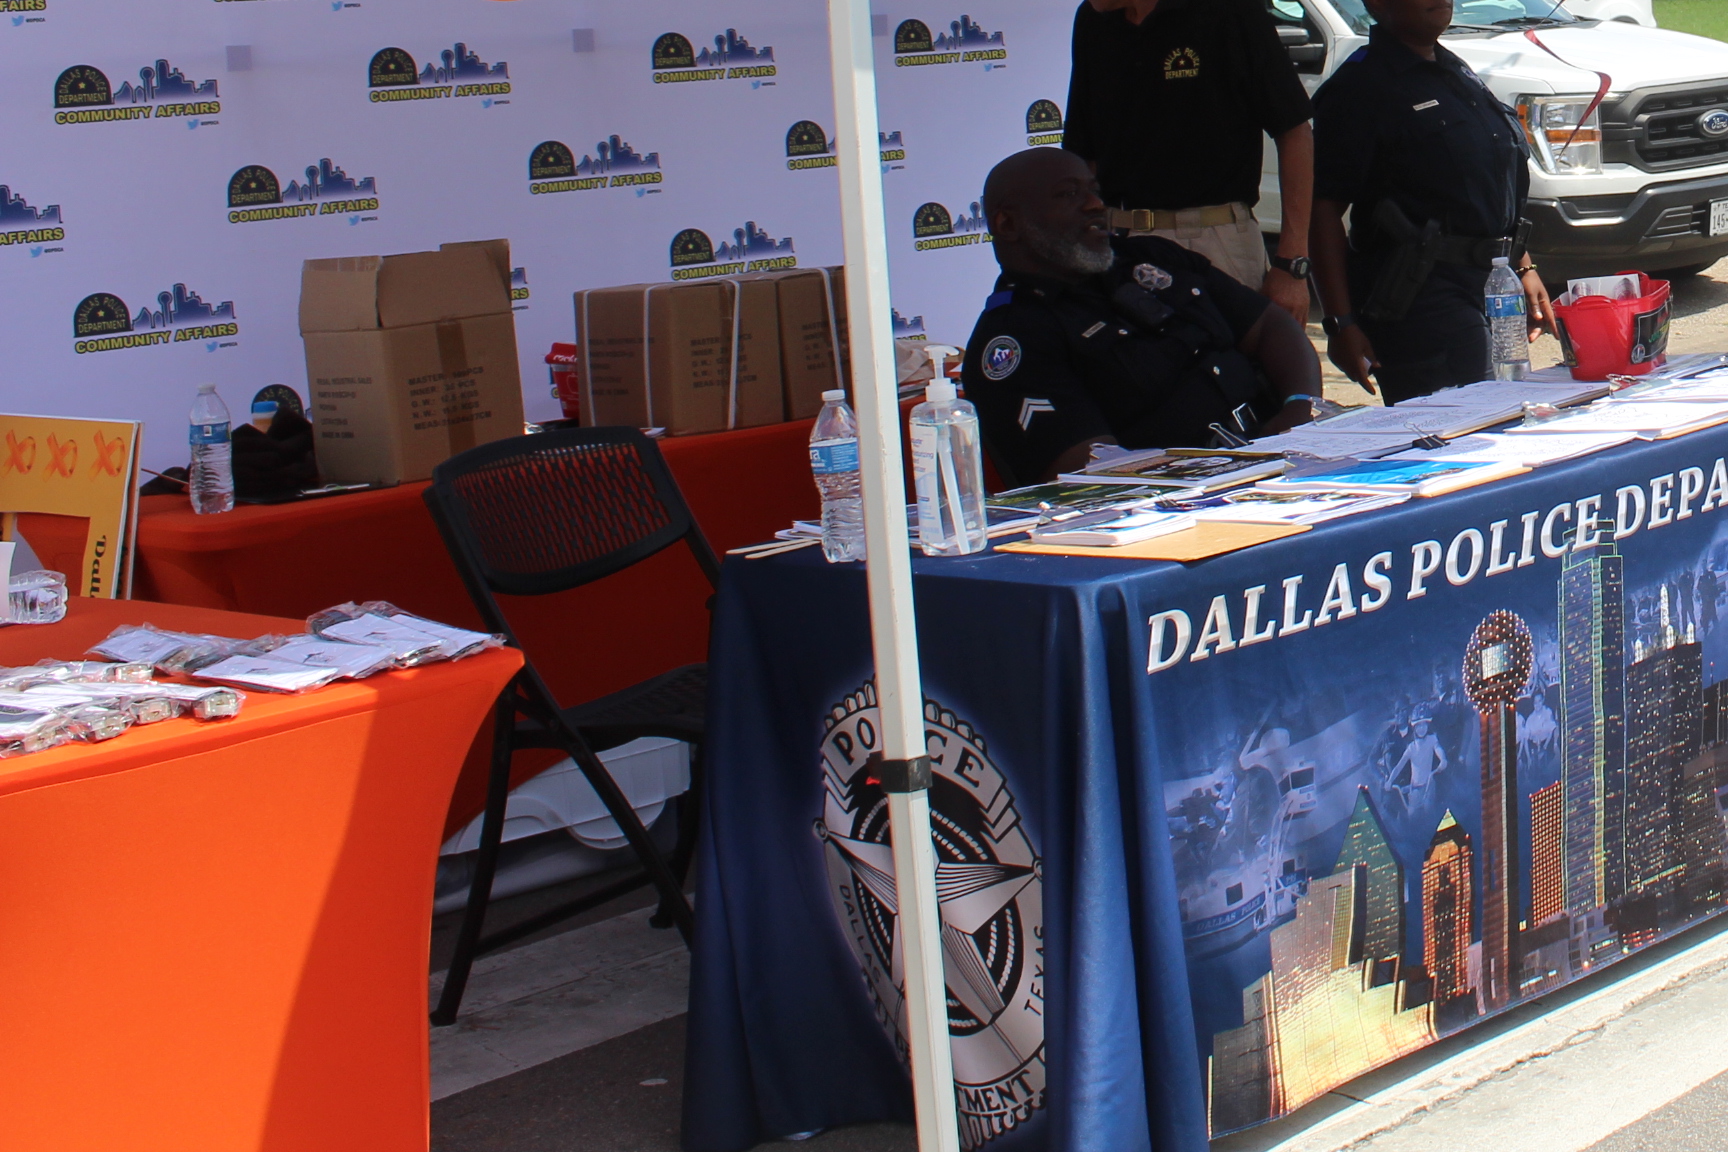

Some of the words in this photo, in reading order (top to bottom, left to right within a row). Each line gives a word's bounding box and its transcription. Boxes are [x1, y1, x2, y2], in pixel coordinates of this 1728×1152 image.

[895, 52, 960, 67] COMMUNITY
[962, 49, 1007, 63] AFFAIRS
[1164, 47, 1182, 70] DALLAS
[1184, 47, 1200, 66] POLICE
[58, 68, 81, 94] DALLAS
[84, 68, 108, 94] POLICE
[372, 73, 414, 84] DEPARTMENT
[653, 69, 726, 84] COMMUNITY
[727, 65, 777, 79] AFFAIRS
[1165, 68, 1199, 80] DEPARTMENT
[58, 92, 107, 104] DEPARTMENT
[369, 86, 453, 102] COMMUNITY
[455, 82, 511, 97] AFFAIRS
[55, 106, 152, 125] COMMUNITY
[156, 101, 220, 118] AFFAIRS
[1712, 117, 1728, 131] Ford
[530, 177, 608, 195] COMMUNITY
[610, 172, 662, 187] AFFAIRS
[232, 191, 276, 204] DEPARTMENT
[228, 204, 317, 223] COMMUNITY
[320, 198, 379, 215] AFFAIRS
[915, 233, 981, 251] COMMUNITY
[672, 264, 746, 281] COMMUNITY
[747, 256, 797, 272] AFFAIRS
[78, 296, 100, 323] DALLAS
[103, 297, 126, 321] POLICE
[78, 319, 126, 334] DEPARTMENT
[75, 330, 171, 354] COMMUNITY
[174, 323, 238, 344] AFFAIRS
[1147, 550, 1394, 675] DALLAS
[1406, 495, 1604, 599] POLICE
[832, 715, 984, 788] POCE
[839, 883, 882, 985] DALLAS
